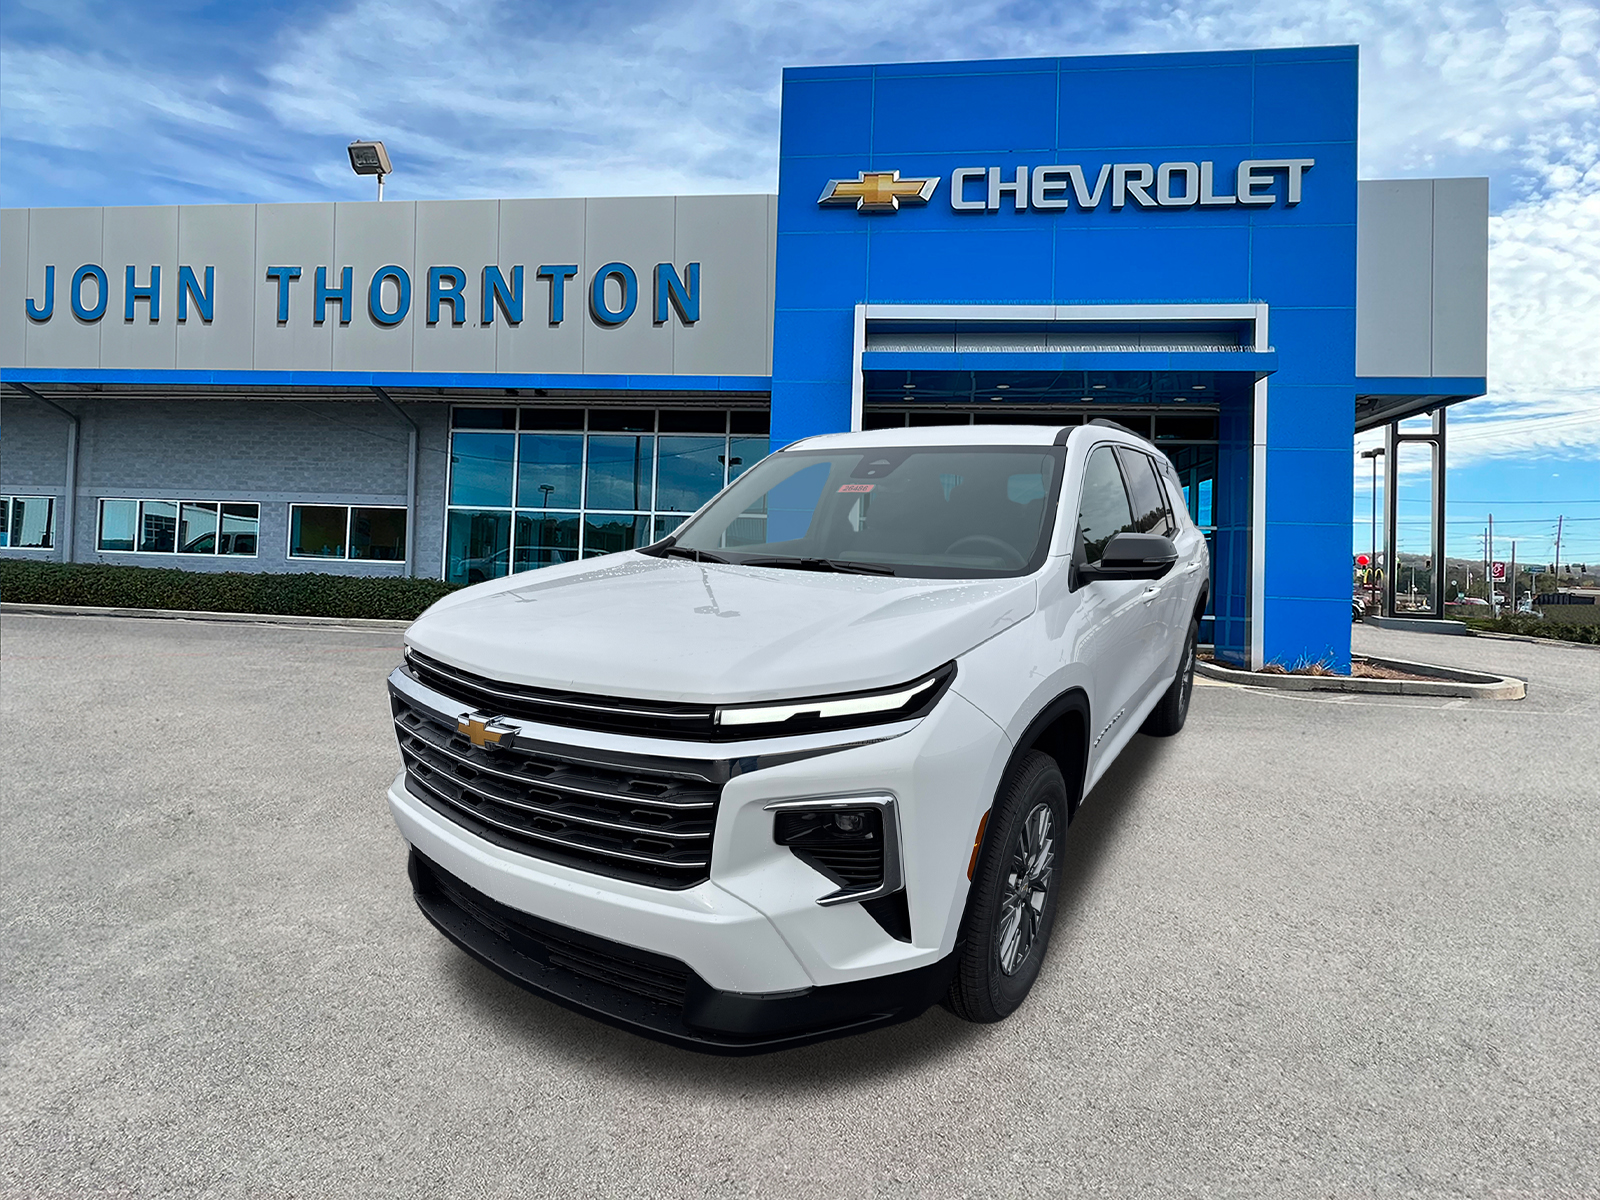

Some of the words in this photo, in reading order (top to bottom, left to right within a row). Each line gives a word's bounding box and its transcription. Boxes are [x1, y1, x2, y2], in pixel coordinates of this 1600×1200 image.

[950, 158, 1315, 213] CHEVROLET
[25, 263, 216, 323] JOHN
[265, 262, 702, 328] THORNTON
